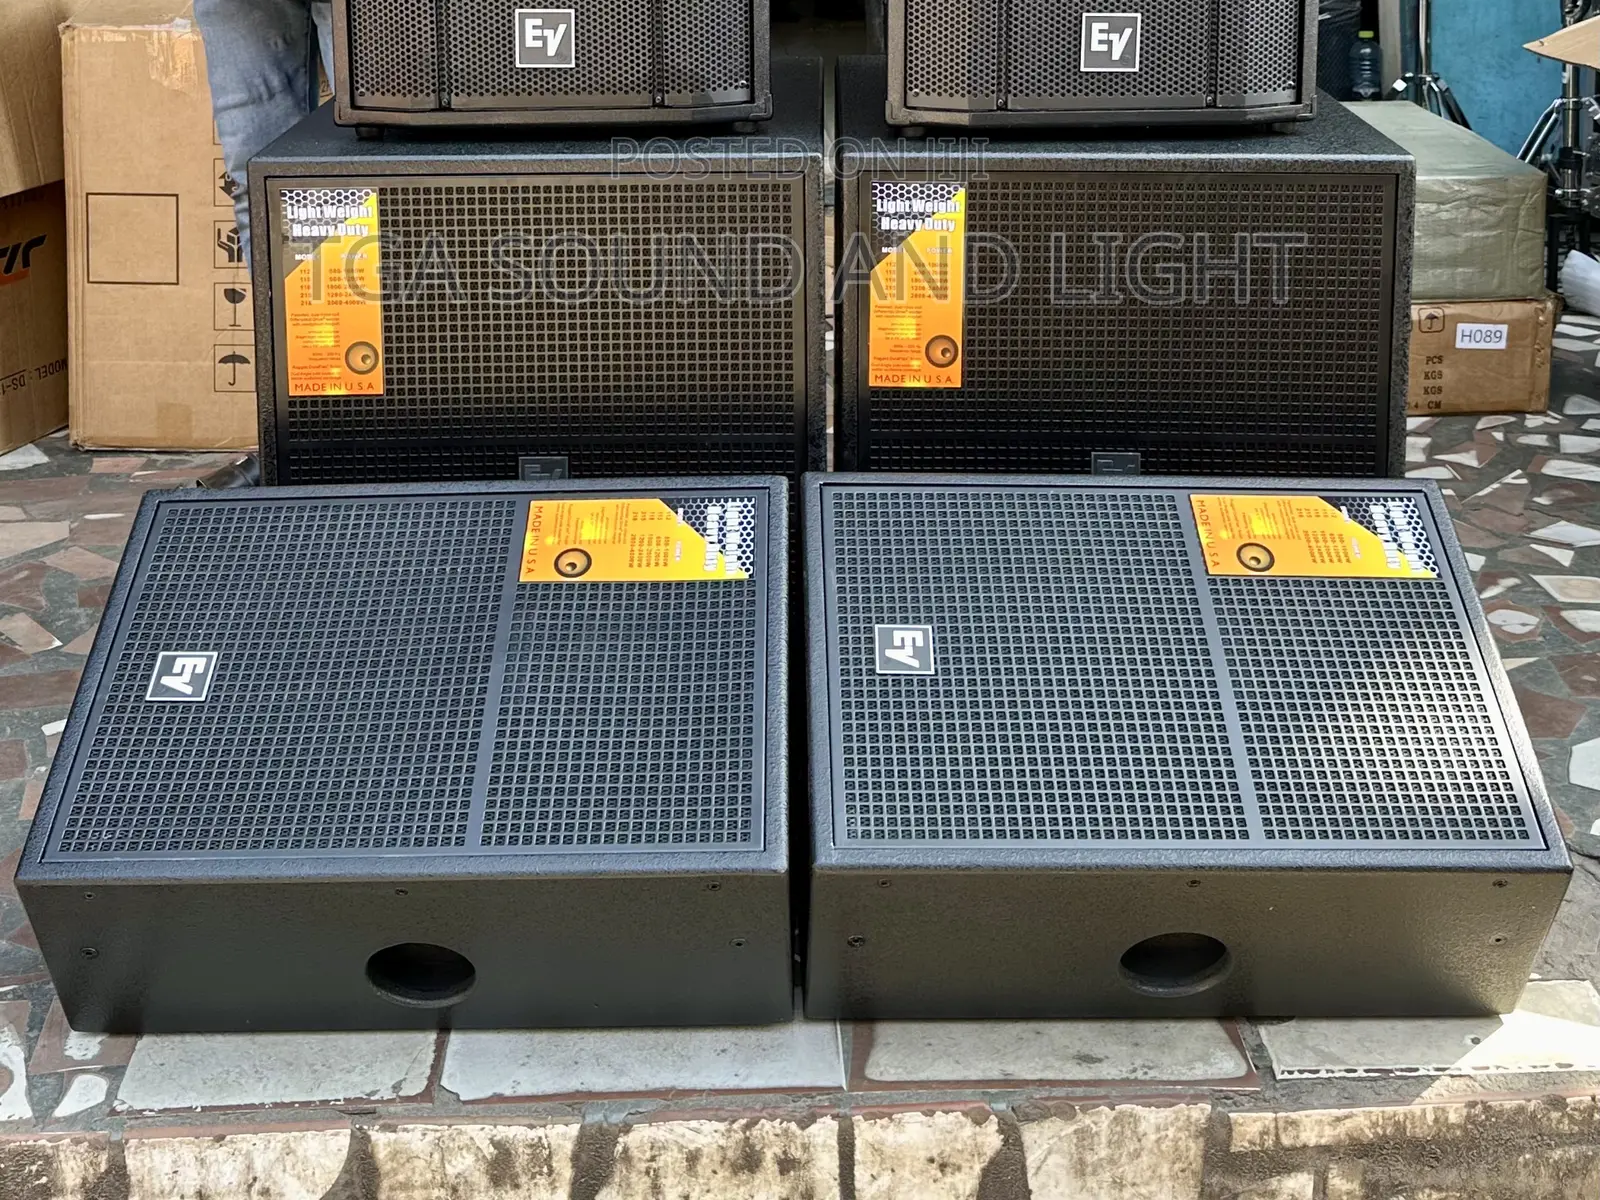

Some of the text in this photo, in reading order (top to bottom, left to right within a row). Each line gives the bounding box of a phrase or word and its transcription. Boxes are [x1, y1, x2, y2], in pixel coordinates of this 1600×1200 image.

[525, 18, 568, 57] EV
[1091, 22, 1133, 61] EV
[287, 204, 373, 220] Light Weight
[876, 198, 960, 214] Light Weight
[292, 223, 369, 238] Heavy Duty
[880, 216, 956, 232] Heavy Duty
[1460, 329, 1503, 344] H089
[1425, 355, 1443, 366] PCS
[874, 374, 906, 384] MADE
[908, 374, 921, 383] IN
[1423, 371, 1443, 380] KGS
[0, 374, 26, 396] DS-1
[294, 383, 326, 392] MADE
[329, 383, 342, 391] IN
[1423, 386, 1443, 396] KGS
[1427, 401, 1442, 410] CM
[531, 505, 544, 533] MADE
[1196, 500, 1211, 527] MADE
[1204, 528, 1213, 540] IN
[533, 535, 540, 545] IN
[885, 630, 924, 669] EV
[160, 657, 207, 695] EV
